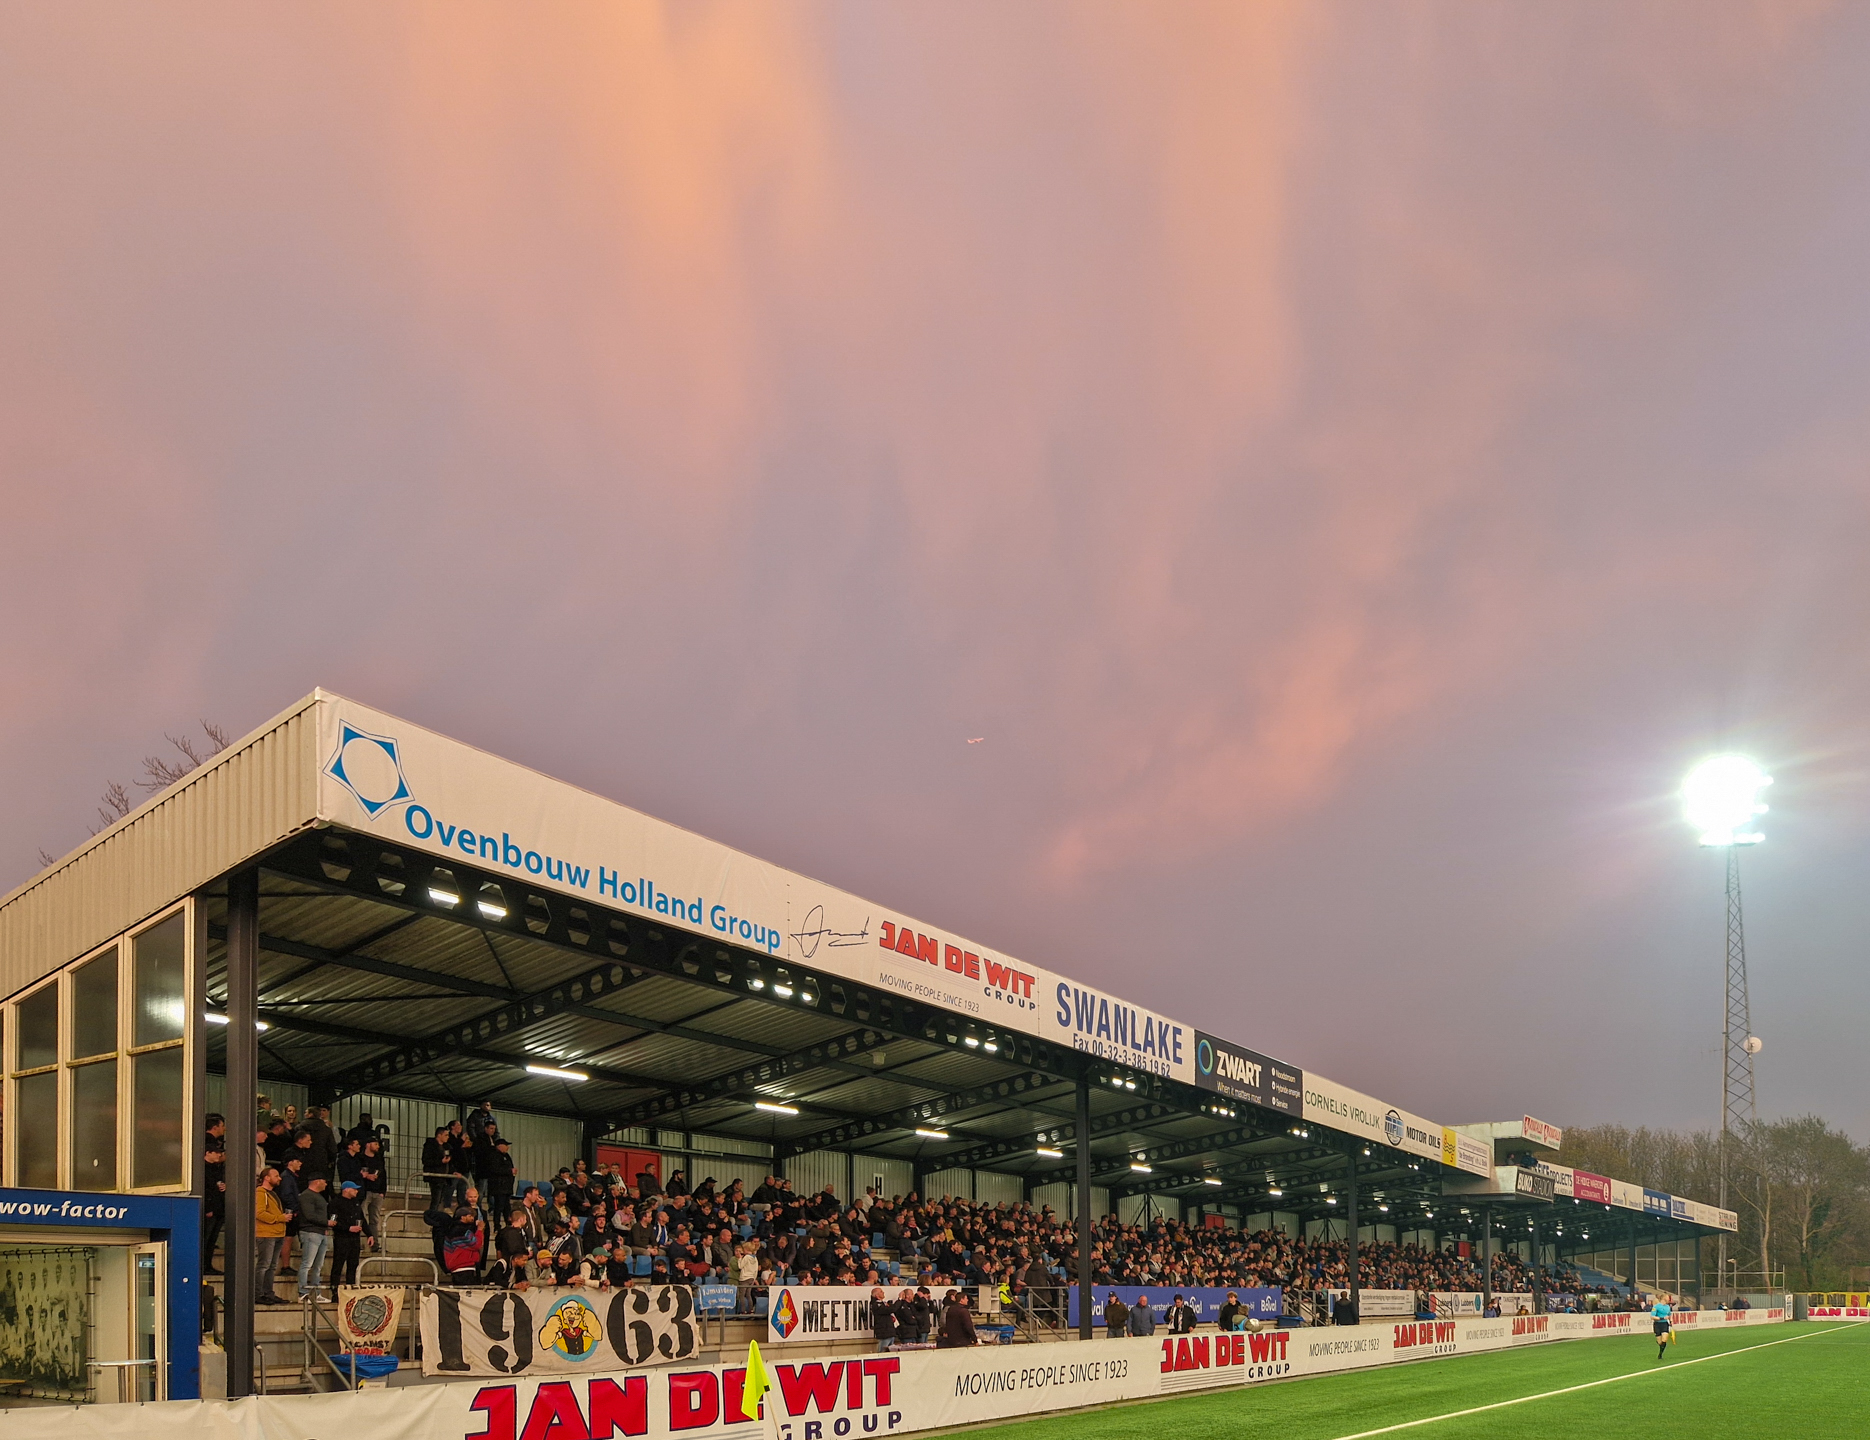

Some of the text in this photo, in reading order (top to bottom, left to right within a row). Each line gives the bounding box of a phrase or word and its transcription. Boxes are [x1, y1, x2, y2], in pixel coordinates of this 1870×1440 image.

[405, 804, 591, 889] Ovenbouw
[599, 865, 703, 925] Holland
[710, 904, 781, 955] Group
[879, 920, 938, 966] JAN
[945, 943, 980, 980] DE
[983, 957, 1035, 999] WIT
[879, 972, 980, 1013] MOVING PEOPLE SINCE 1923
[984, 986, 1036, 1011] GROUP
[1056, 982, 1183, 1065] SWANLAKE
[1073, 1033, 1089, 1053] Fax
[1149, 1059, 1159, 1076] 19
[1161, 1063, 1171, 1079] 62
[1216, 1049, 1262, 1088] ZWART
[1217, 1081, 1230, 1095] When
[1304, 1090, 1380, 1129] CORNELIS VROLIJK
[1406, 1126, 1428, 1146] MOTOR
[1428, 1134, 1441, 1150] OILS
[875, 1176, 882, 1196] H
[0, 1200, 128, 1219] wow-factor
[1512, 1317, 1526, 1335] JAN
[1535, 1315, 1549, 1333] WIT
[1592, 1314, 1606, 1329] JAN
[1607, 1313, 1617, 1328] DE
[1617, 1313, 1631, 1327] WIT
[1808, 1308, 1841, 1316] JAN
[1309, 1338, 1380, 1357] MOVING PEOPLE SINCE 1923
[1393, 1321, 1456, 1348] JAN DE WIT
[1160, 1331, 1290, 1374] JAN DE WIT
[955, 1359, 1128, 1397] MOVING PEOPLE SINCE 1923
[1248, 1363, 1290, 1378] GROUP
[465, 1375, 648, 1440] JAN
[775, 1356, 900, 1417] WIT
